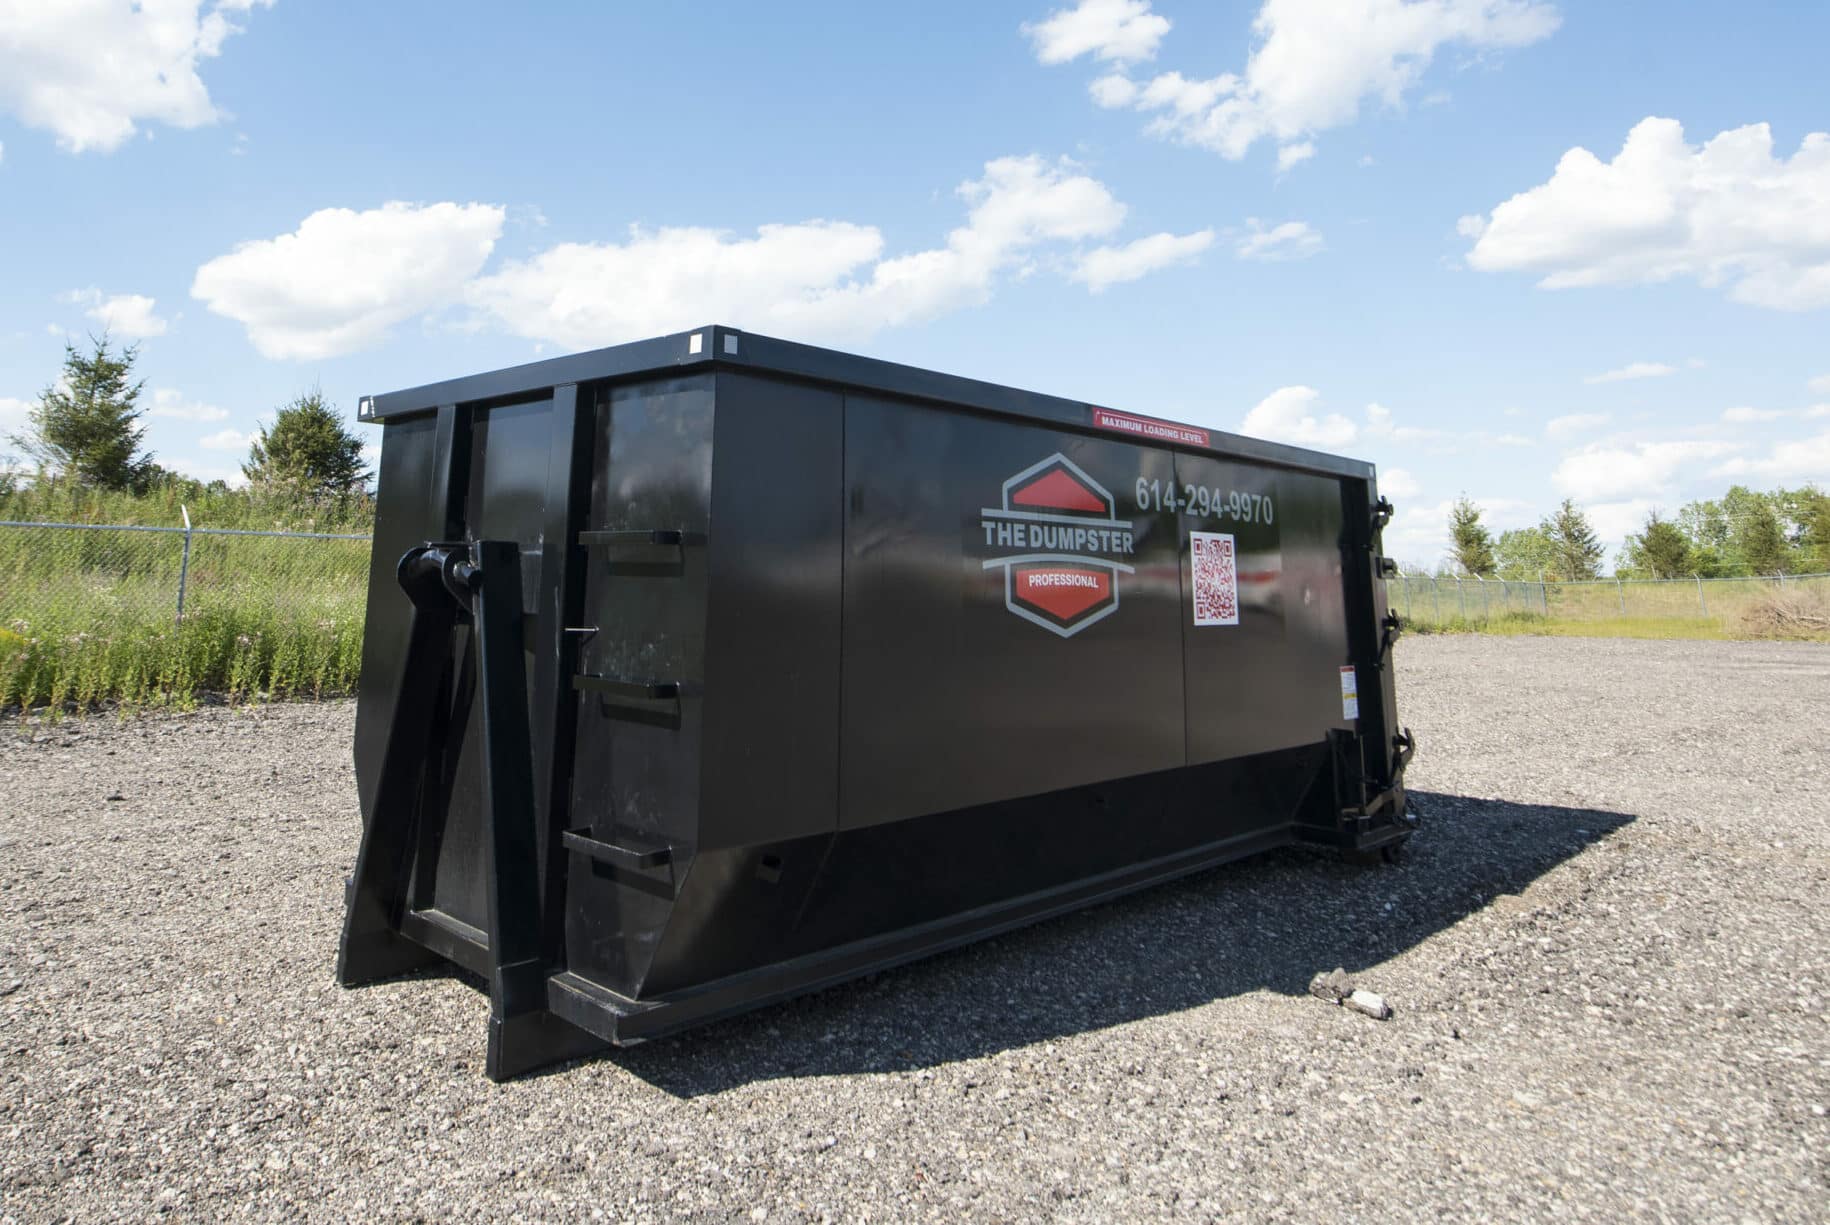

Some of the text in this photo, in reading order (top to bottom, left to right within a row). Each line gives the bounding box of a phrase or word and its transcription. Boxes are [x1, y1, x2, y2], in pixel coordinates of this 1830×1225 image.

[1101, 415, 1204, 443] MAXIMUM LOADING LEVEL
[1135, 476, 1273, 525] 614-294-9970
[981, 521, 1135, 553] THE DUMPSTER
[1028, 573, 1099, 589] PROFESSIONAL
